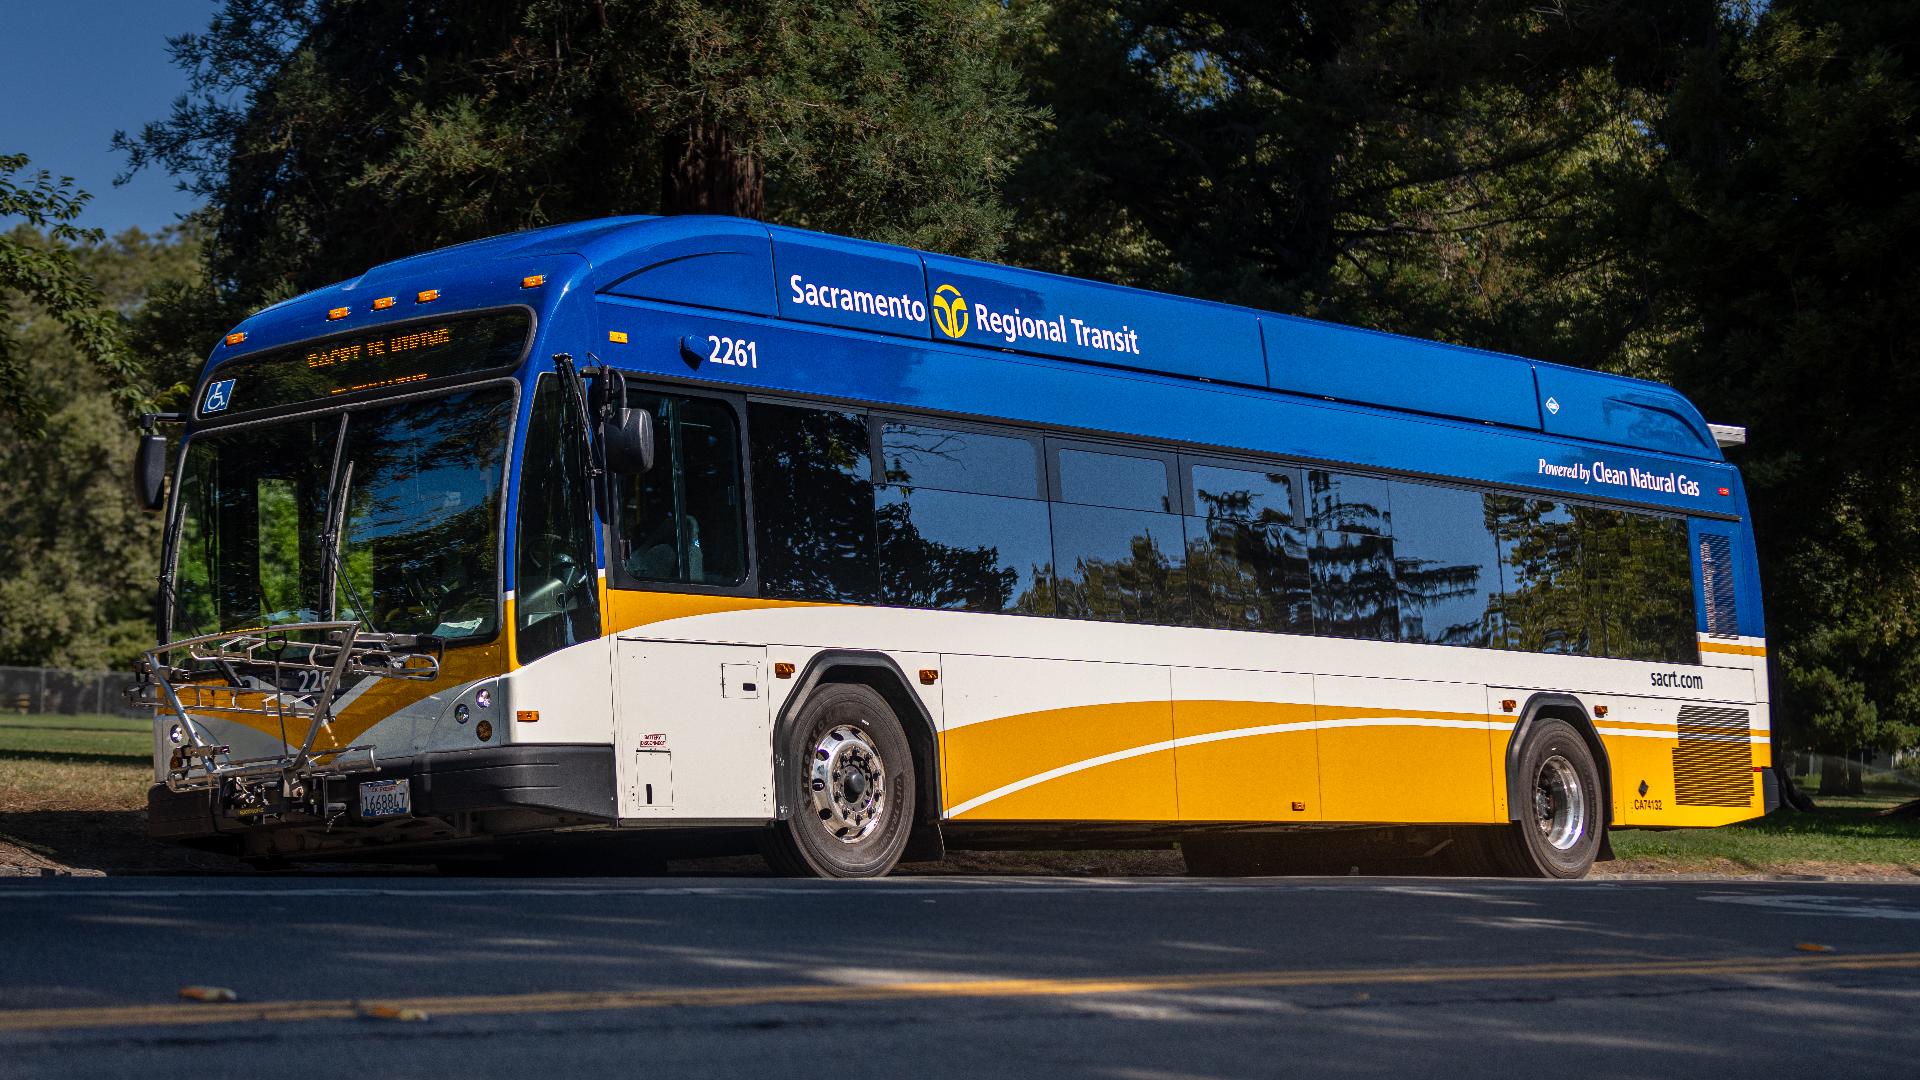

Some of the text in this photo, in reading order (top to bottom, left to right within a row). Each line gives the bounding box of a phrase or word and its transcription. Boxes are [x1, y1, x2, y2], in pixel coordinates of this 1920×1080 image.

[790, 274, 1140, 355] Sacramento Regional Transit
[708, 335, 757, 369] 2261
[1538, 458, 1700, 497] Powered by Clean Natural Gas
[1650, 670, 1703, 690] sacrt.com
[364, 793, 405, 811] 1668847
[1634, 799, 1663, 811] CA74132
